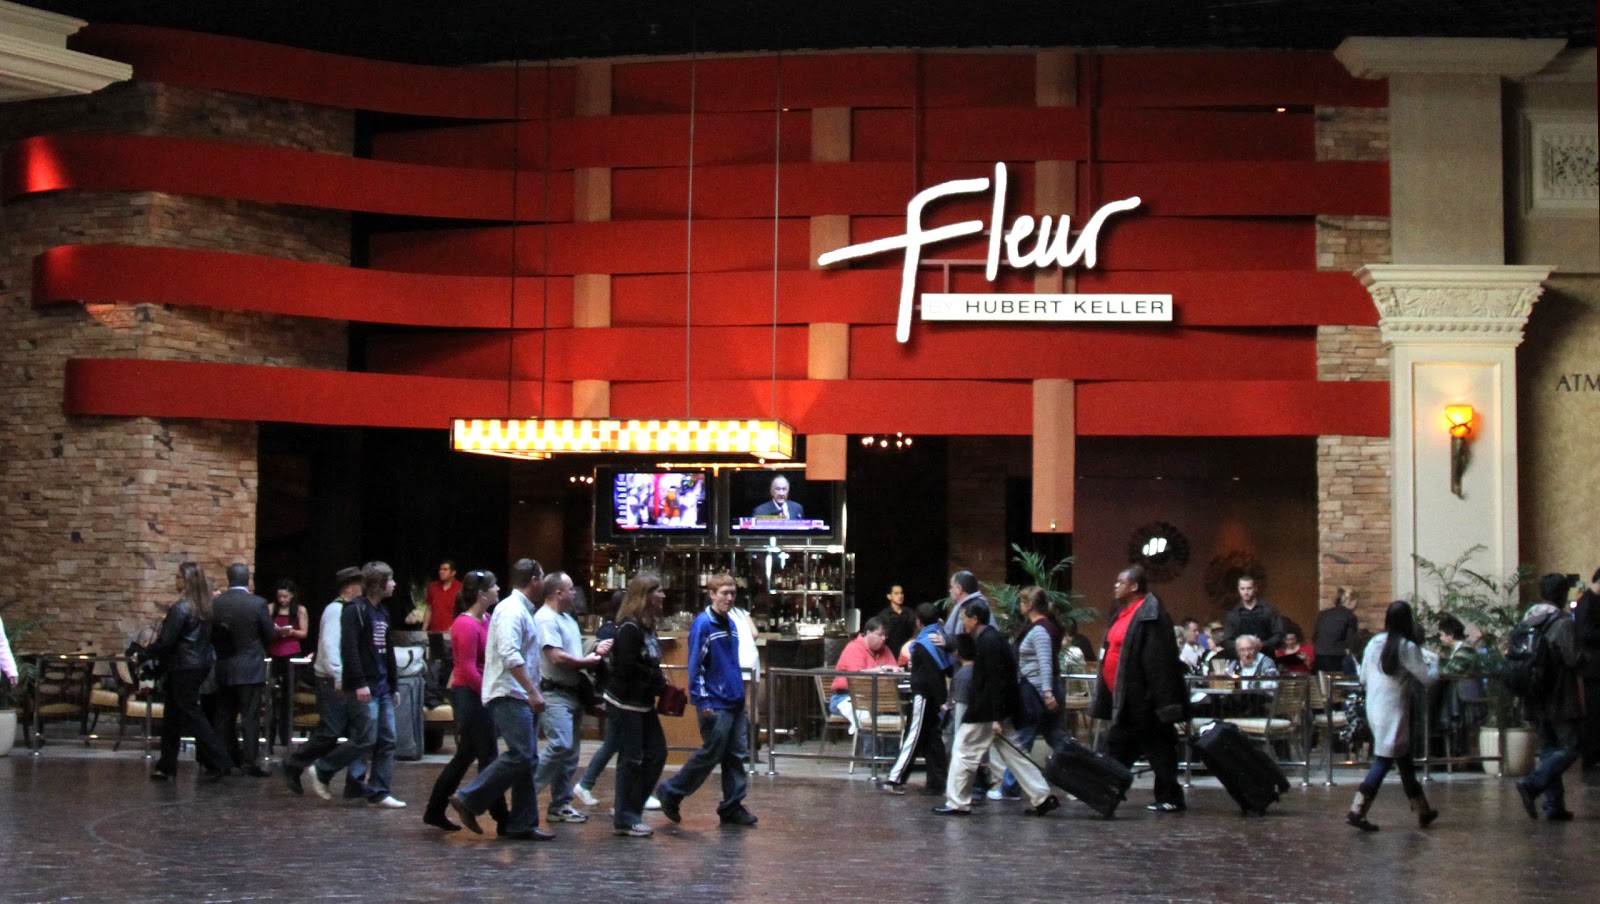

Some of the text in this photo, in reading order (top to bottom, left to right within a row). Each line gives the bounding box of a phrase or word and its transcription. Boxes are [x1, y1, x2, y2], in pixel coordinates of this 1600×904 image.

[818, 162, 1141, 343] Fleur
[966, 300, 1062, 314] HUBERT
[1074, 300, 1164, 314] KELLER
[1555, 373, 1600, 392] ATM
